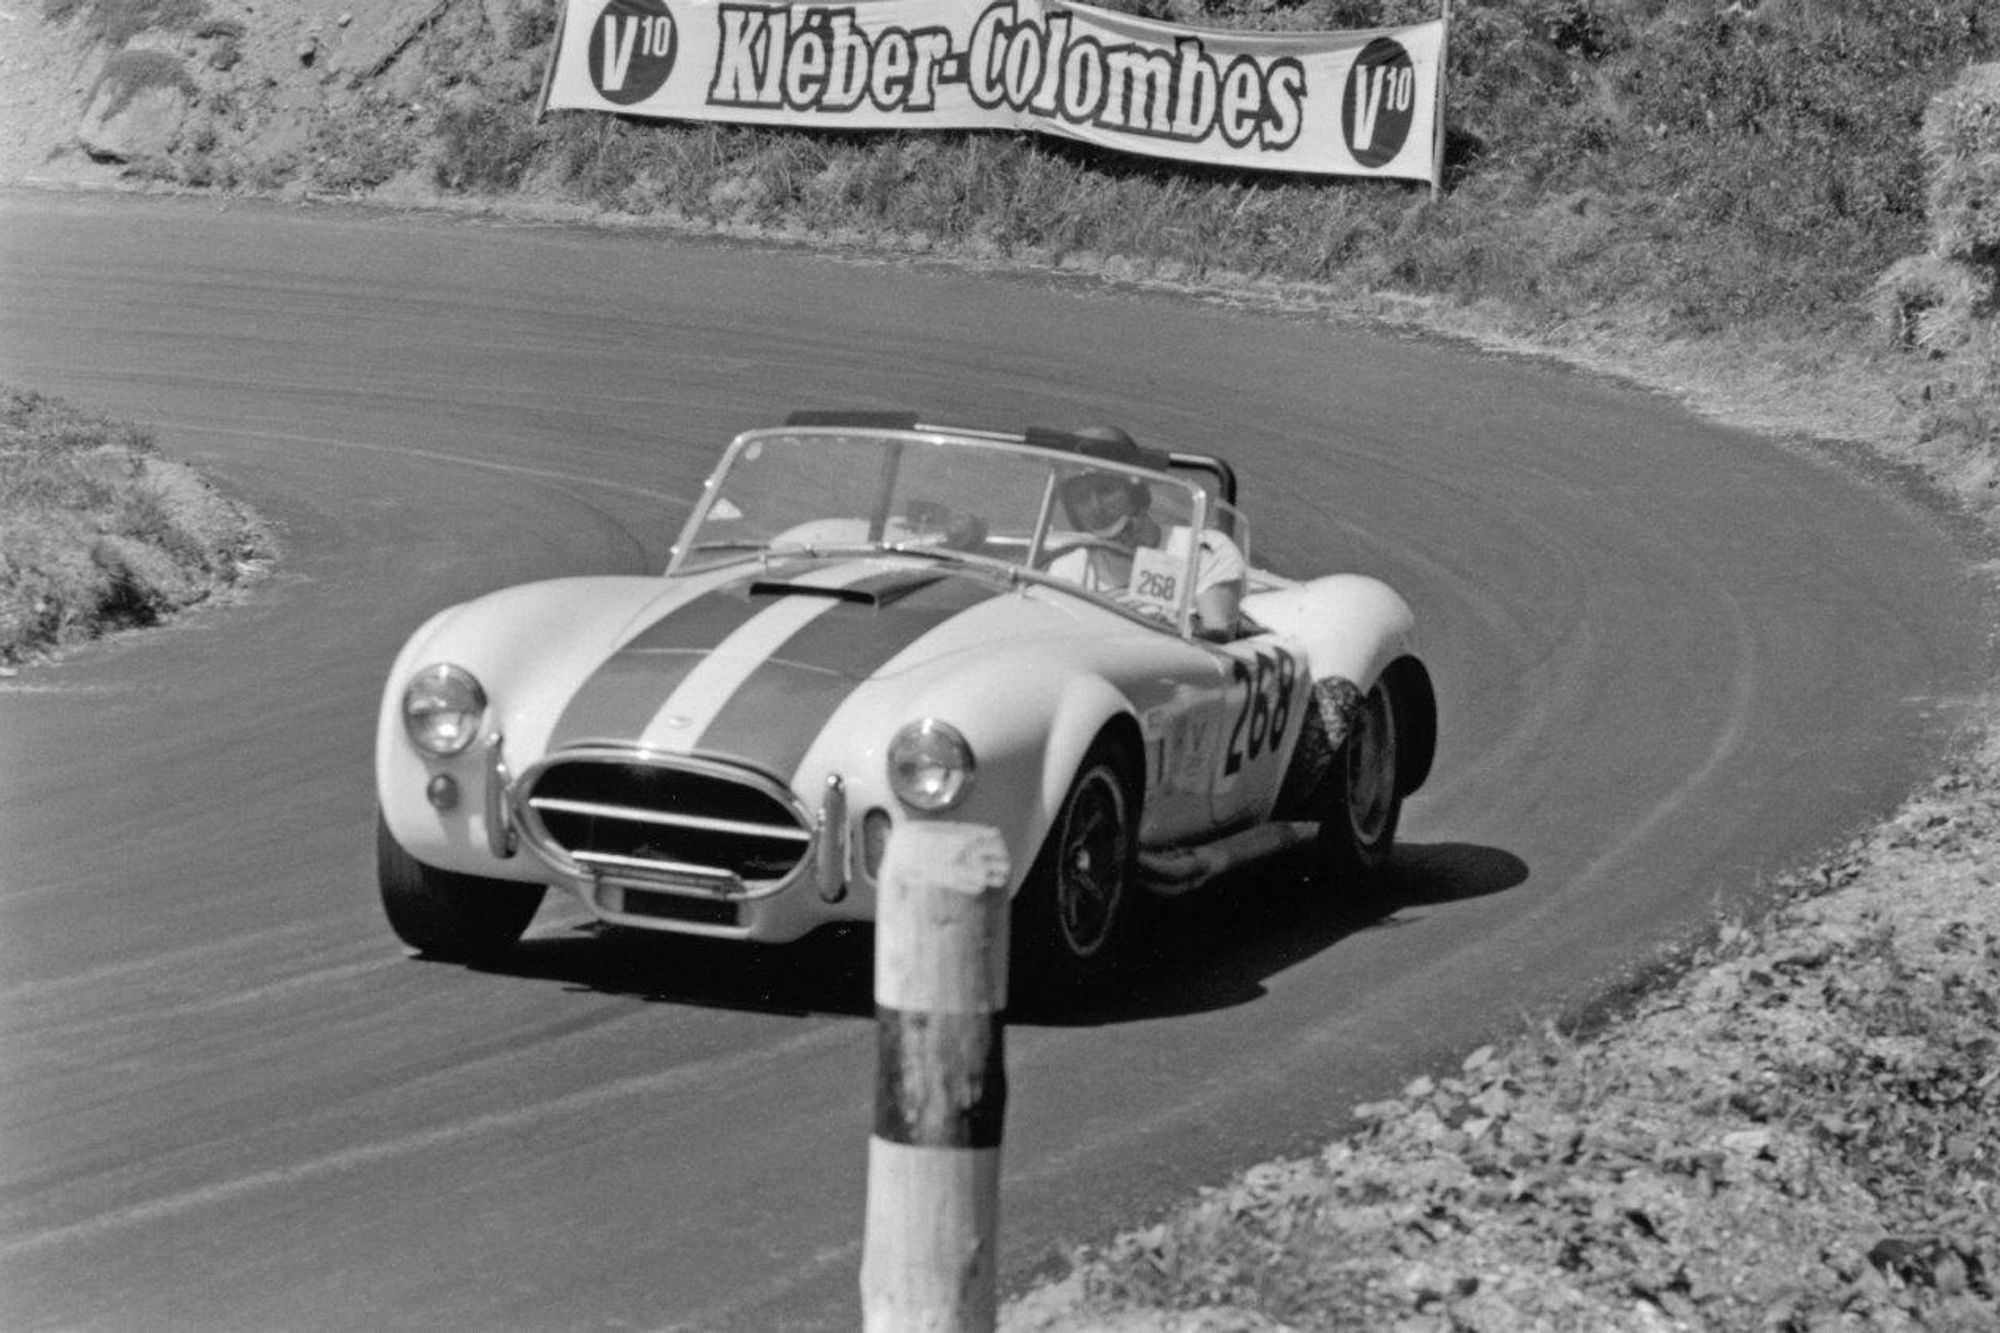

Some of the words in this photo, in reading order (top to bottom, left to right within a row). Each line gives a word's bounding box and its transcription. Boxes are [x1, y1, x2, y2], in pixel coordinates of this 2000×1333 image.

[705, 0, 1308, 151] Kléber-Colombes
[1138, 570, 1177, 601] 268
[1224, 646, 1295, 777] 268
